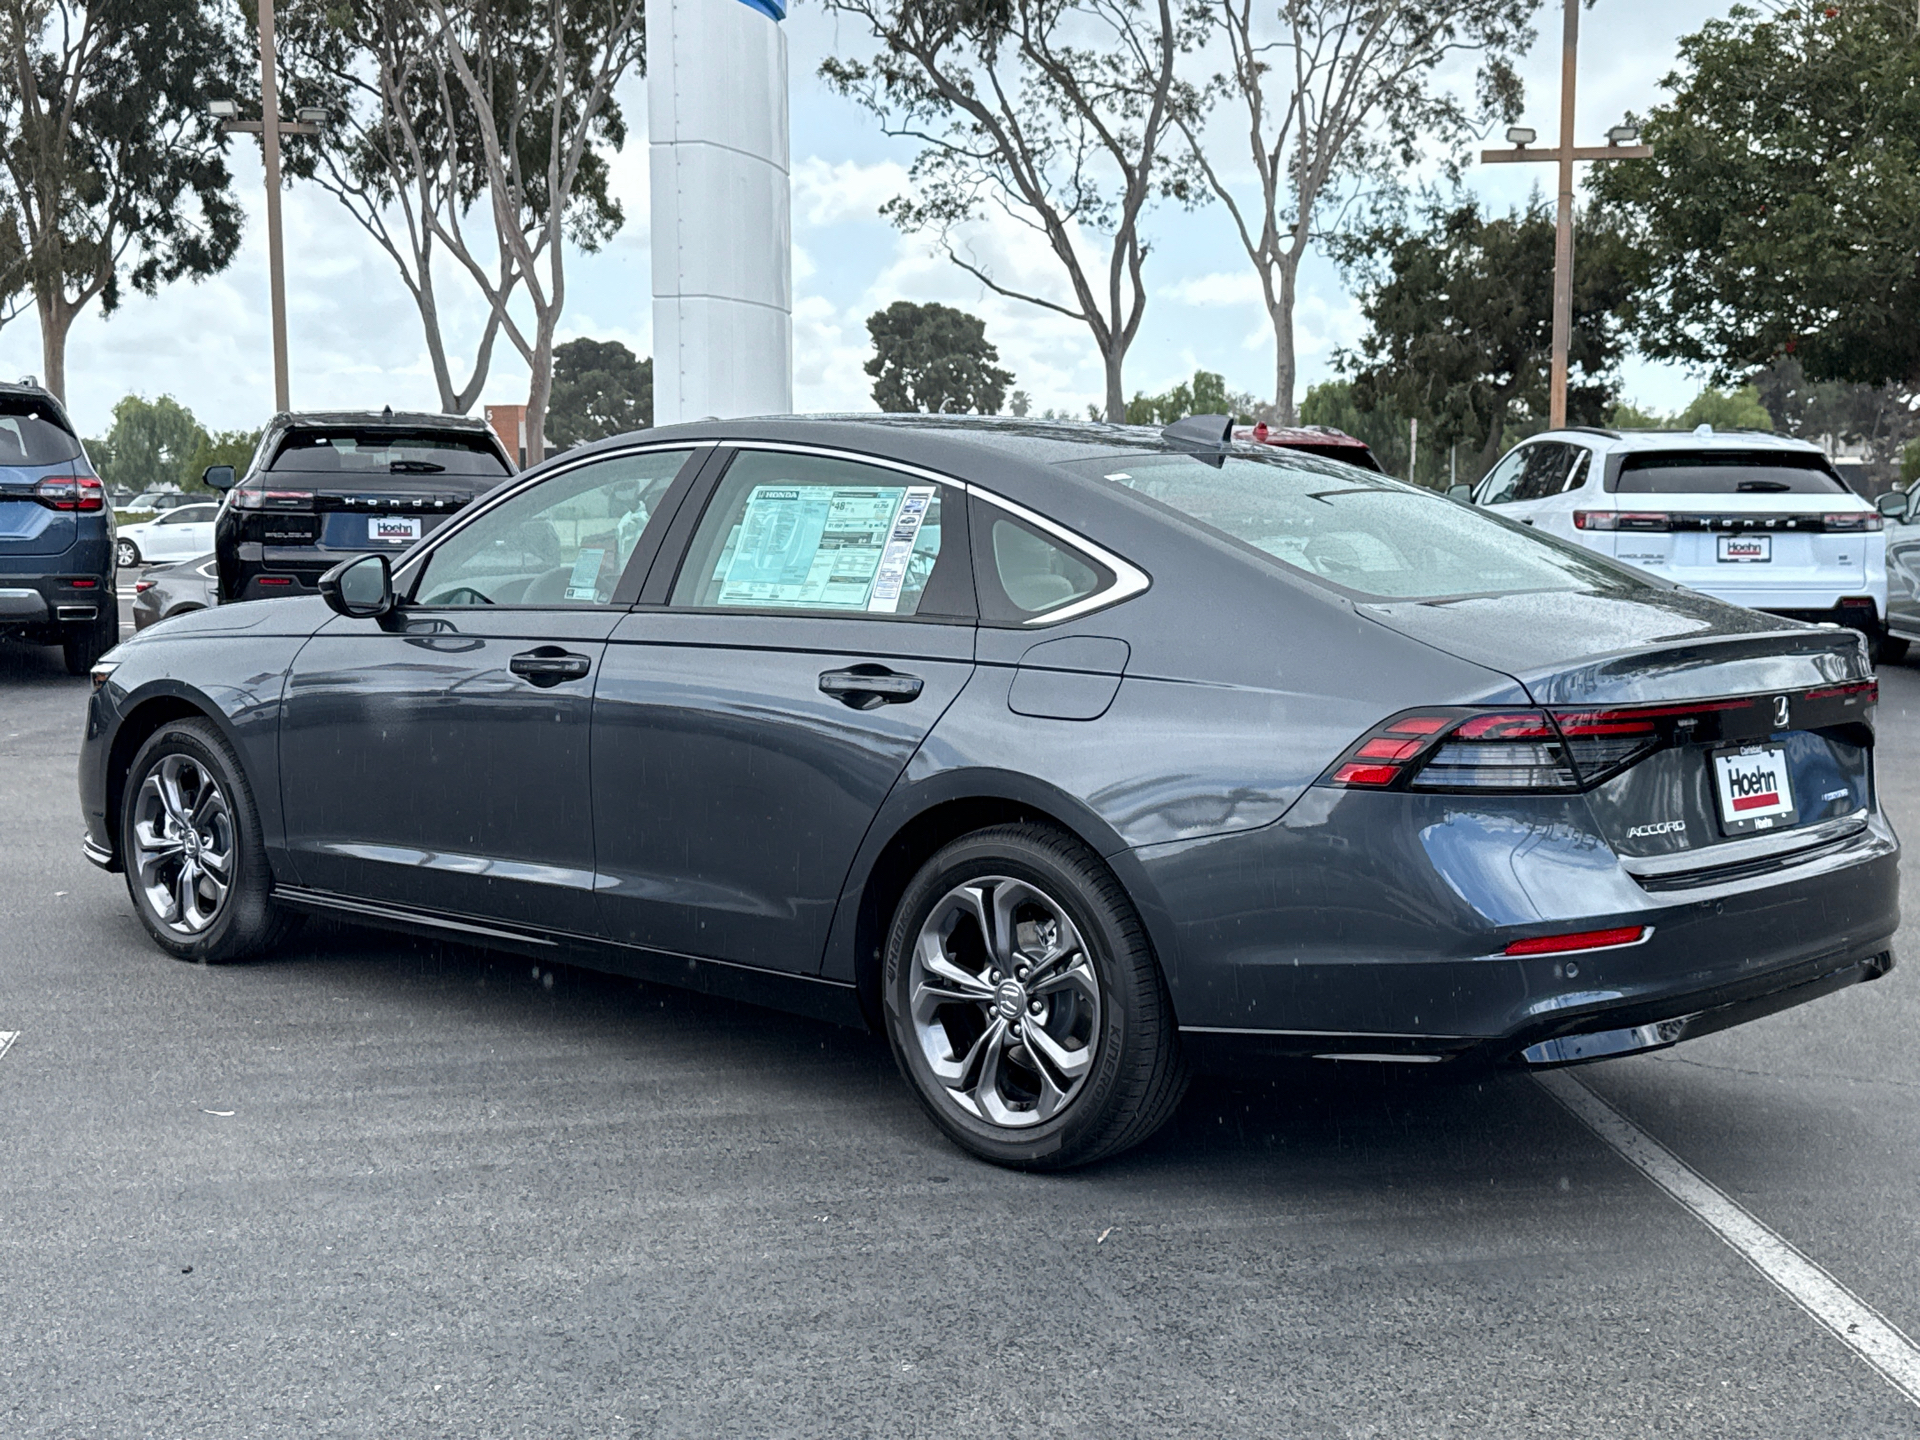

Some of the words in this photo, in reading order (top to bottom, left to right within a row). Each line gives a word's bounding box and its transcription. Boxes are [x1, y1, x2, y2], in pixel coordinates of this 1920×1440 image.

[486, 409, 494, 421] 5
[377, 523, 412, 534] Hoehn
[1728, 542, 1761, 553] Hoehn
[1727, 765, 1778, 798] Hoehn
[1626, 820, 1686, 838] ACCORD
